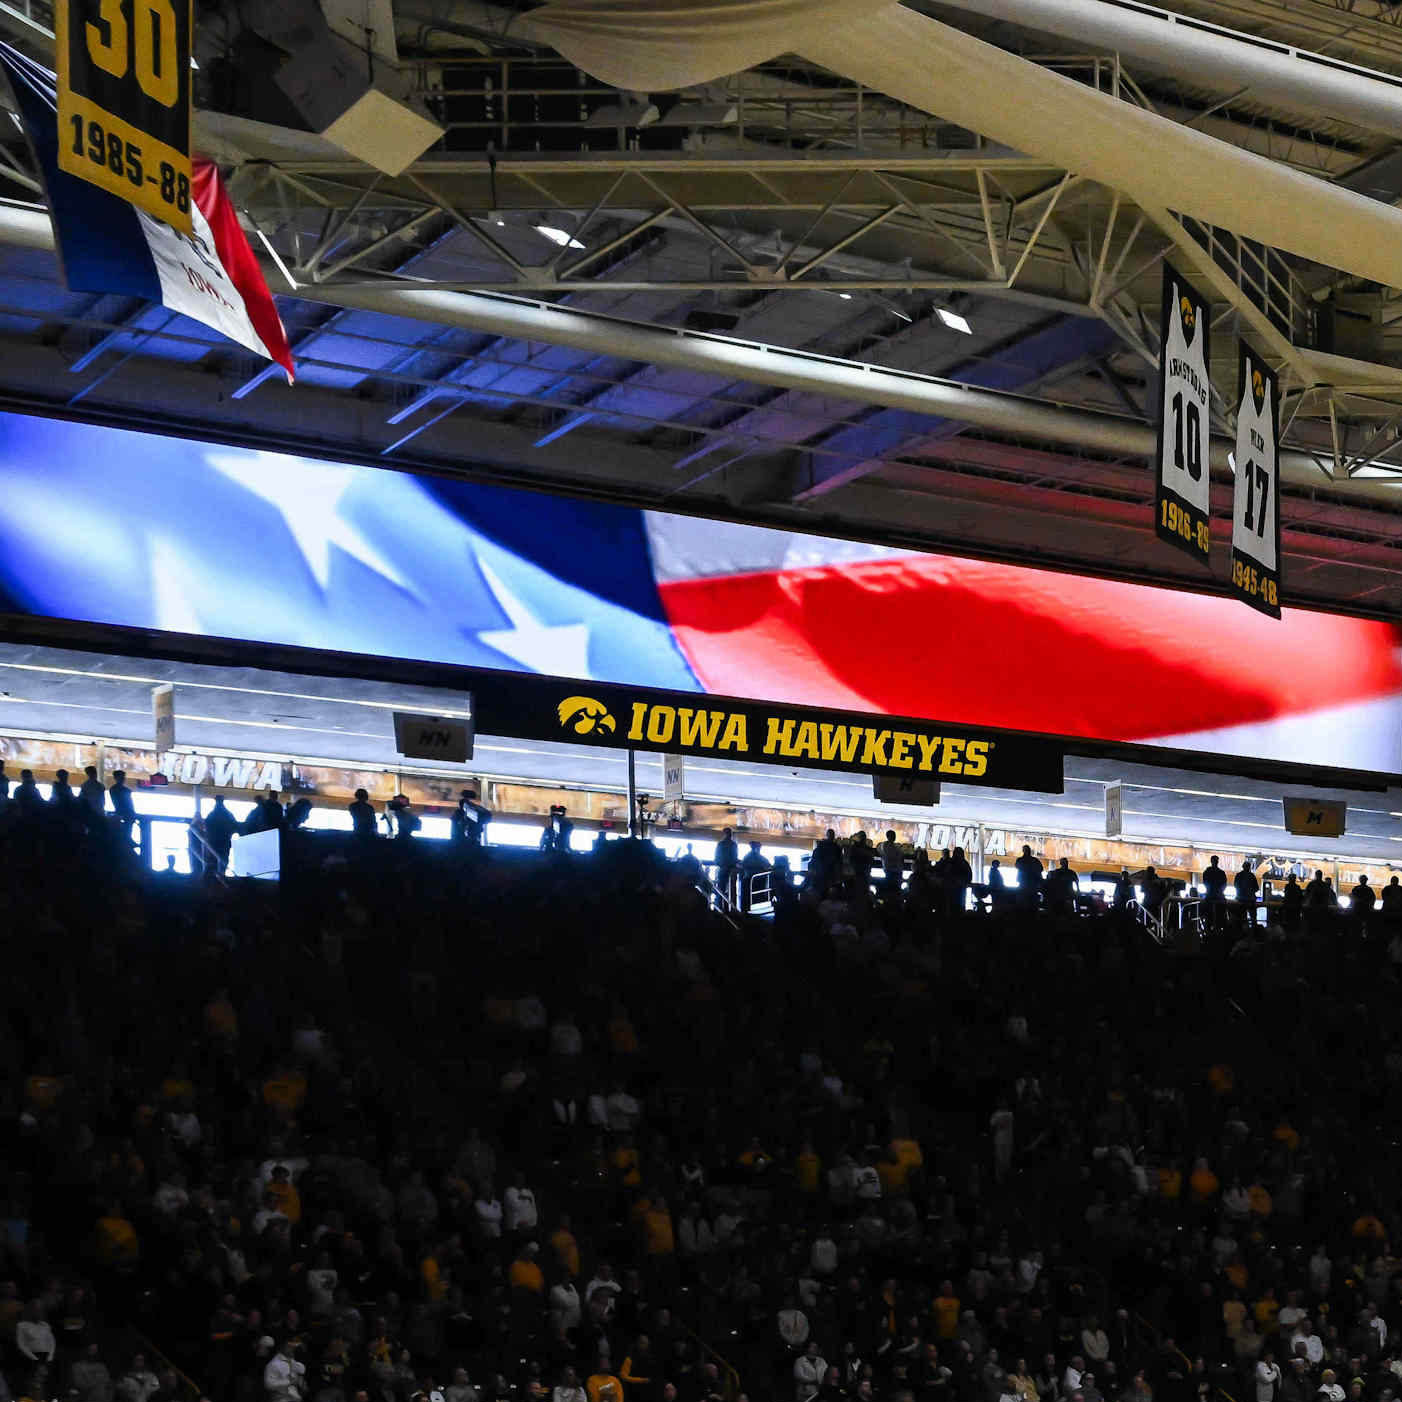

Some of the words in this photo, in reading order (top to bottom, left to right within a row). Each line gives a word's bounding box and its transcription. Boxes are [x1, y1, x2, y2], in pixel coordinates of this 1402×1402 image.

[70, 114, 191, 215] 1985-88
[1172, 391, 1201, 482] 10
[1244, 458, 1269, 539] 17
[160, 752, 283, 792] IOWA
[628, 703, 749, 752] IOWA
[762, 717, 989, 777] HAWKEYES
[914, 823, 1006, 856] IOWA
